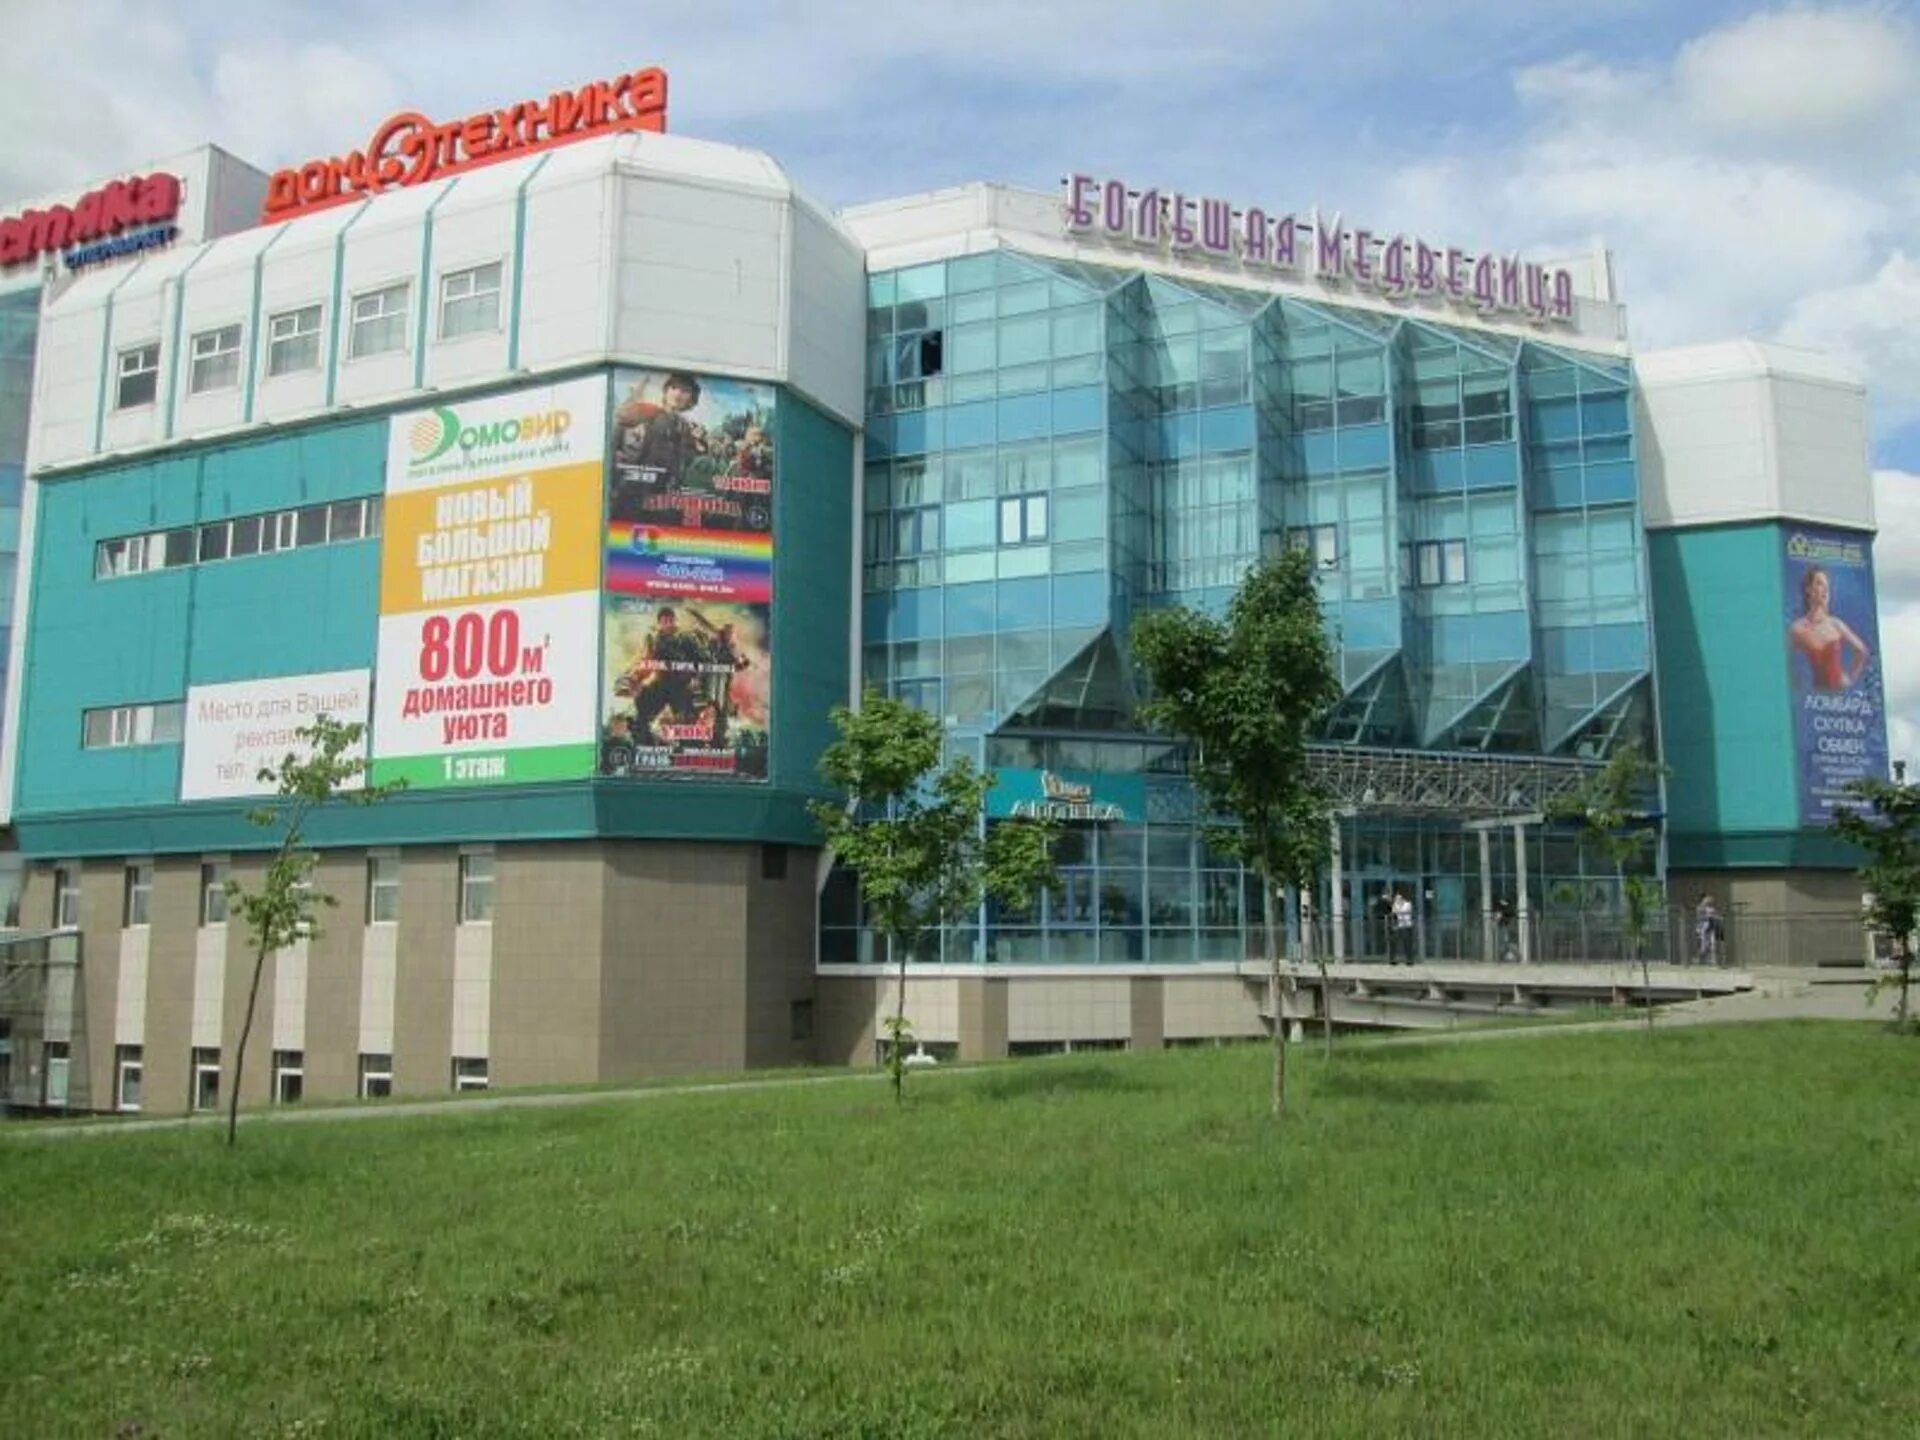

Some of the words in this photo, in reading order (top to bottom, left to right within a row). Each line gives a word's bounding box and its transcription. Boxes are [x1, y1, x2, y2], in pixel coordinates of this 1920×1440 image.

[1066, 174, 1300, 264] БОЛЬШАЯ
[1312, 204, 1574, 322] МЕДВЕДИЦА
[436, 475, 533, 529] НОВЫЙ
[416, 508, 551, 567] БОЛЬШОЙ
[421, 554, 543, 604] МАГАЗИН
[198, 700, 252, 722] Место
[256, 699, 291, 720] для
[296, 687, 359, 716] Вашей
[402, 676, 553, 718] домашнего
[442, 711, 508, 744] уюта
[442, 756, 452, 780] 1
[455, 754, 506, 779] этаж
